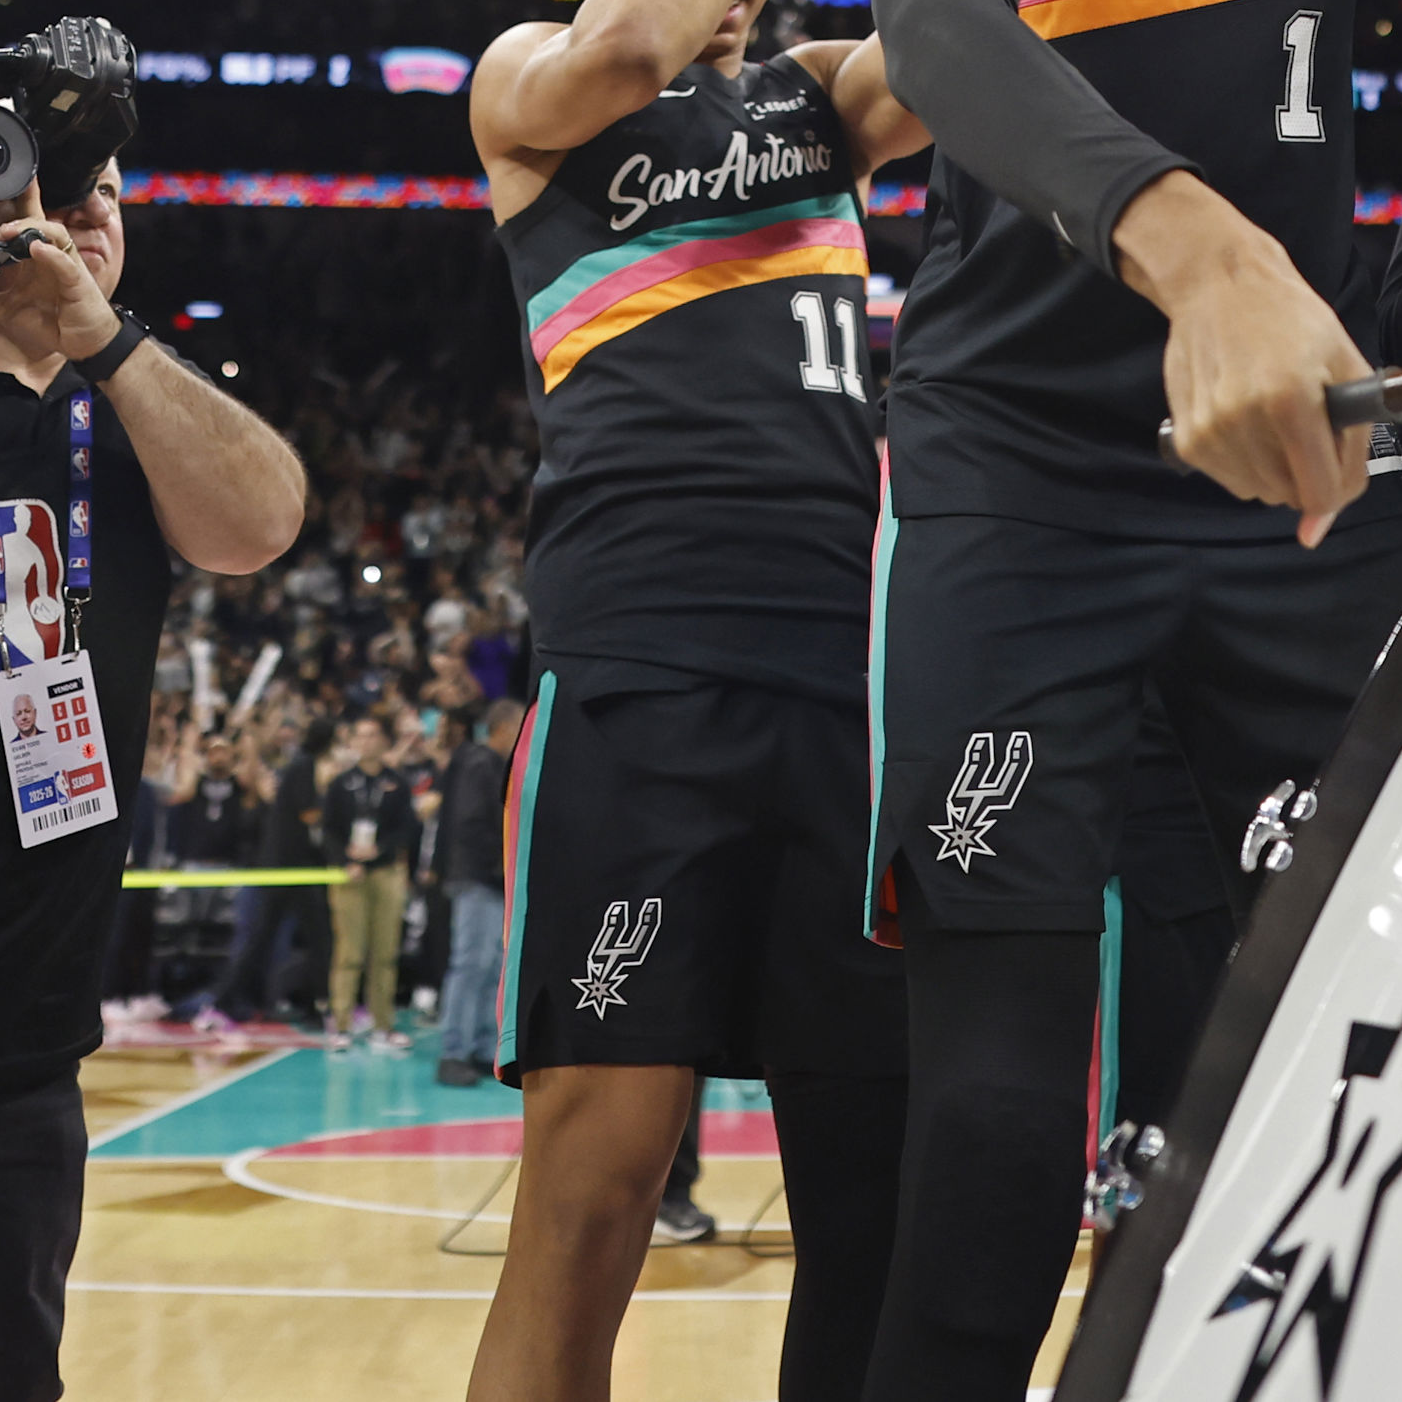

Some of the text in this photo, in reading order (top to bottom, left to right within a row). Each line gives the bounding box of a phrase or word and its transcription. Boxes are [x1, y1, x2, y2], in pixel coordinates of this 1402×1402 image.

[1274, 9, 1327, 143] 1
[607, 130, 833, 232] San Antonio
[790, 290, 868, 403] 11
[53, 681, 78, 694] VENDOR
[28, 772, 95, 804] 2025-26 SEASON
